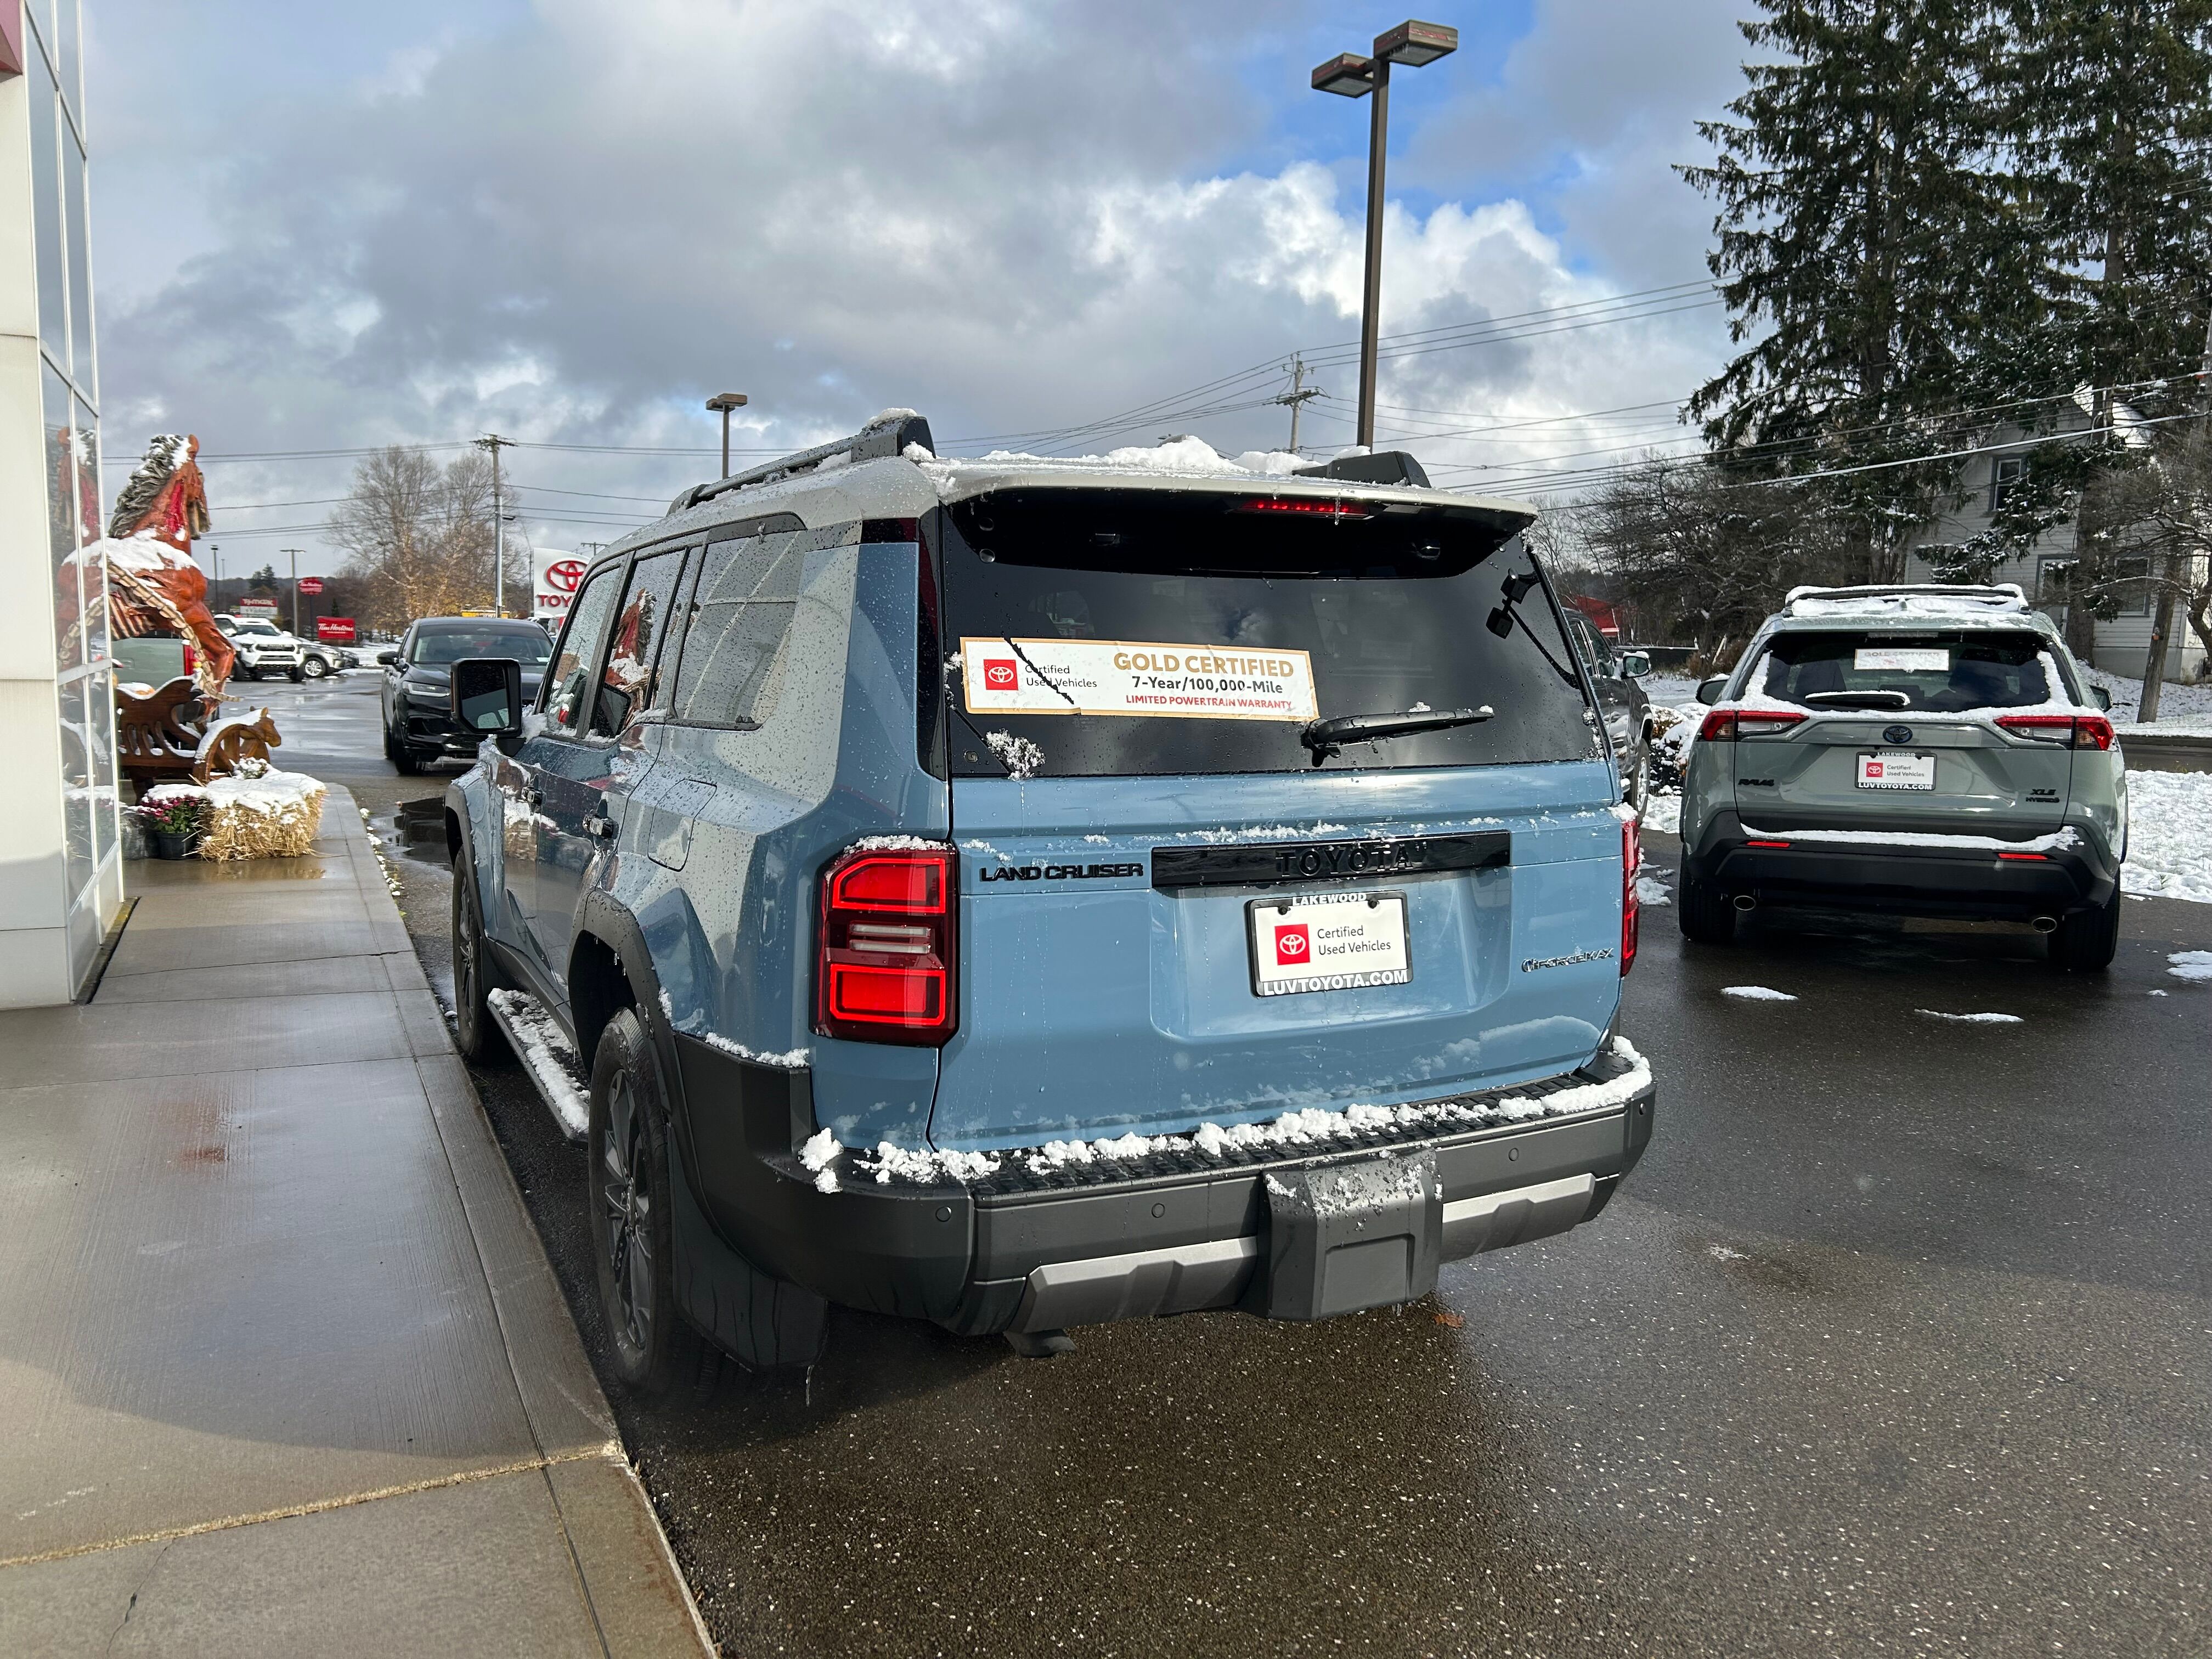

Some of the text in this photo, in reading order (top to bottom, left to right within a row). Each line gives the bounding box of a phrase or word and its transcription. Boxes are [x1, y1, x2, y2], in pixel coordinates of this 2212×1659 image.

[318, 623, 353, 631] Tim Hortons
[1025, 664, 1070, 674] Crtified
[1114, 652, 1294, 678] GOLD CERTIFIED
[1054, 678, 1097, 689] Vehicles
[1131, 676, 1283, 693] 7-Year/100,000-Mile
[1126, 695, 1292, 709] LIMITED POWERTRAIN WARRANTY
[1858, 782, 1932, 791] LUVTOYOTA.COM
[1276, 844, 1414, 877] TOYOTA
[979, 862, 1144, 882] LAND CRUISER
[1291, 893, 1367, 906] LAKEWOOD
[1317, 924, 1364, 939] Certified
[1318, 940, 1392, 956] Used Vehicles
[1263, 969, 1409, 996] LUVTOYOTA.COM
